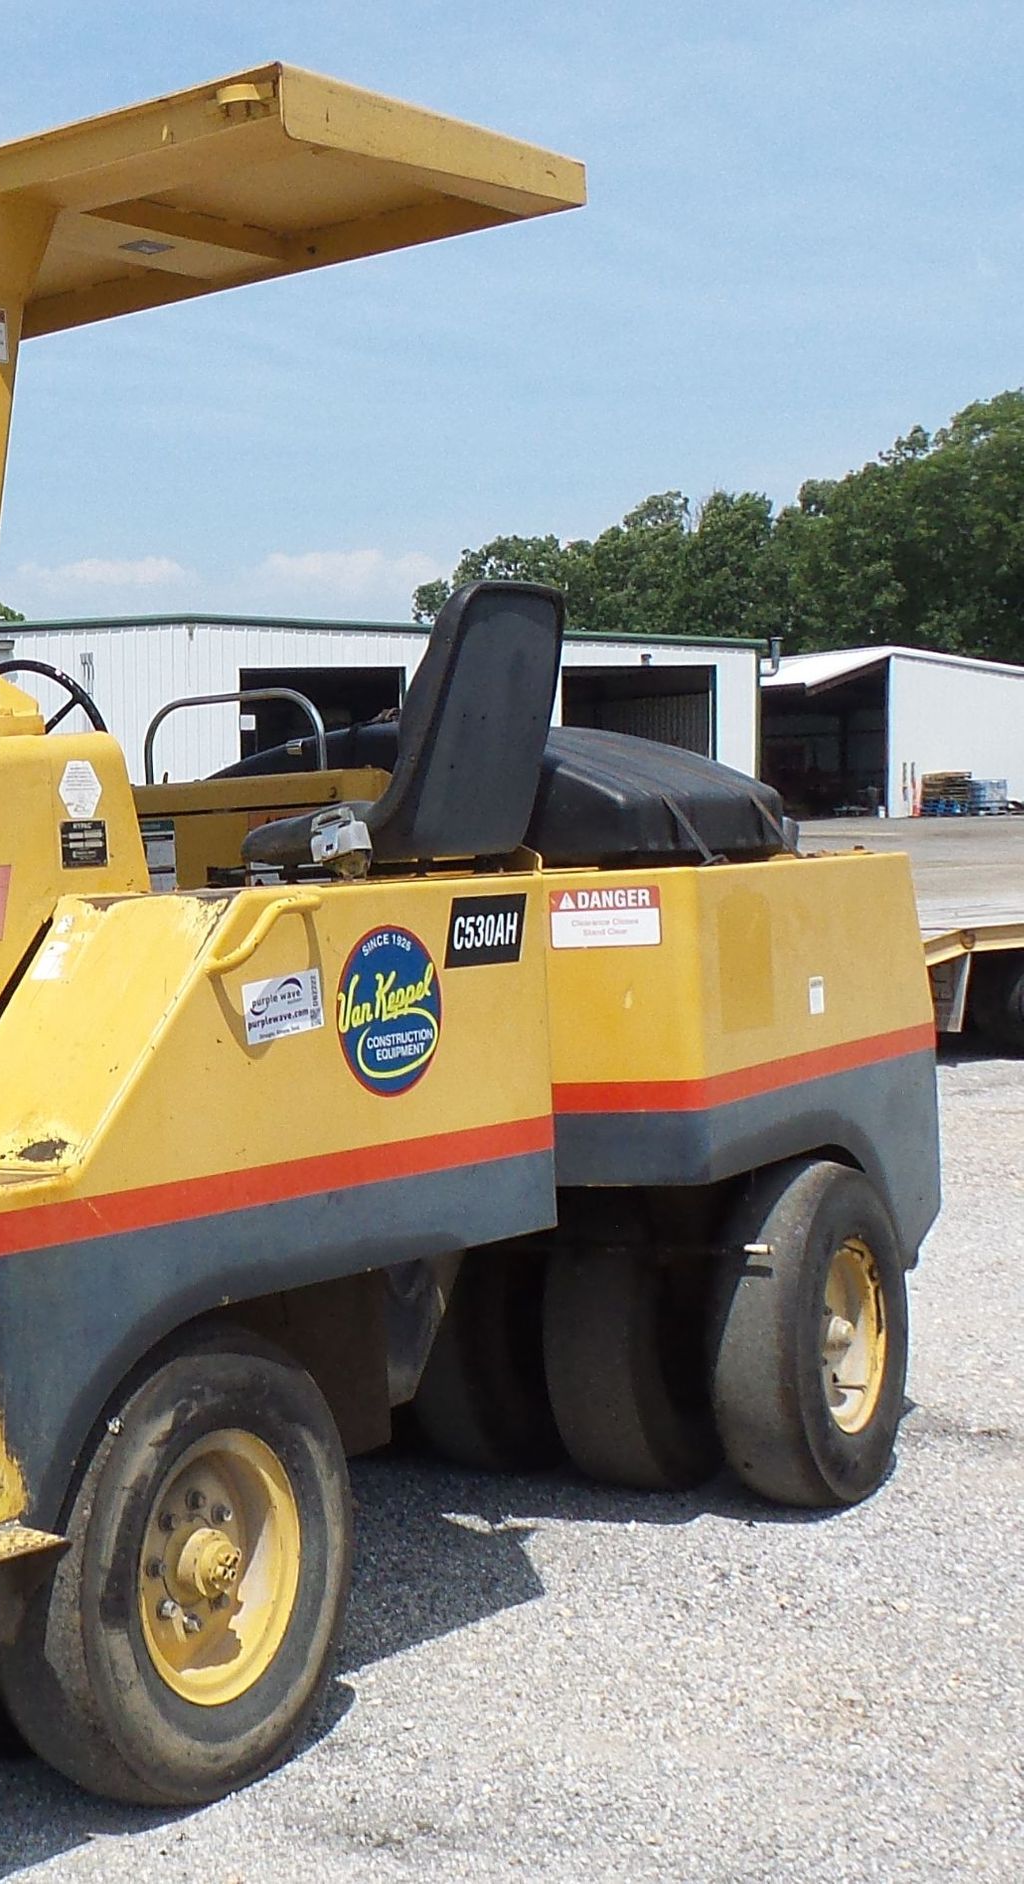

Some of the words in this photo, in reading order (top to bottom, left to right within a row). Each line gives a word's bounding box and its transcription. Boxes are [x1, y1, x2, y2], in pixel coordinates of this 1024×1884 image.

[576, 888, 651, 909] DANGER
[453, 911, 519, 951] C530AH
[361, 934, 390, 957] SINCE
[251, 994, 278, 1009] purple
[280, 989, 301, 1001] wave
[337, 973, 373, 1034] Van
[375, 962, 434, 1022] Keppel
[247, 1008, 309, 1032] purplewave.com
[366, 1028, 434, 1049] CONSTRUCTION
[375, 1042, 426, 1061] EQUIPMENT
